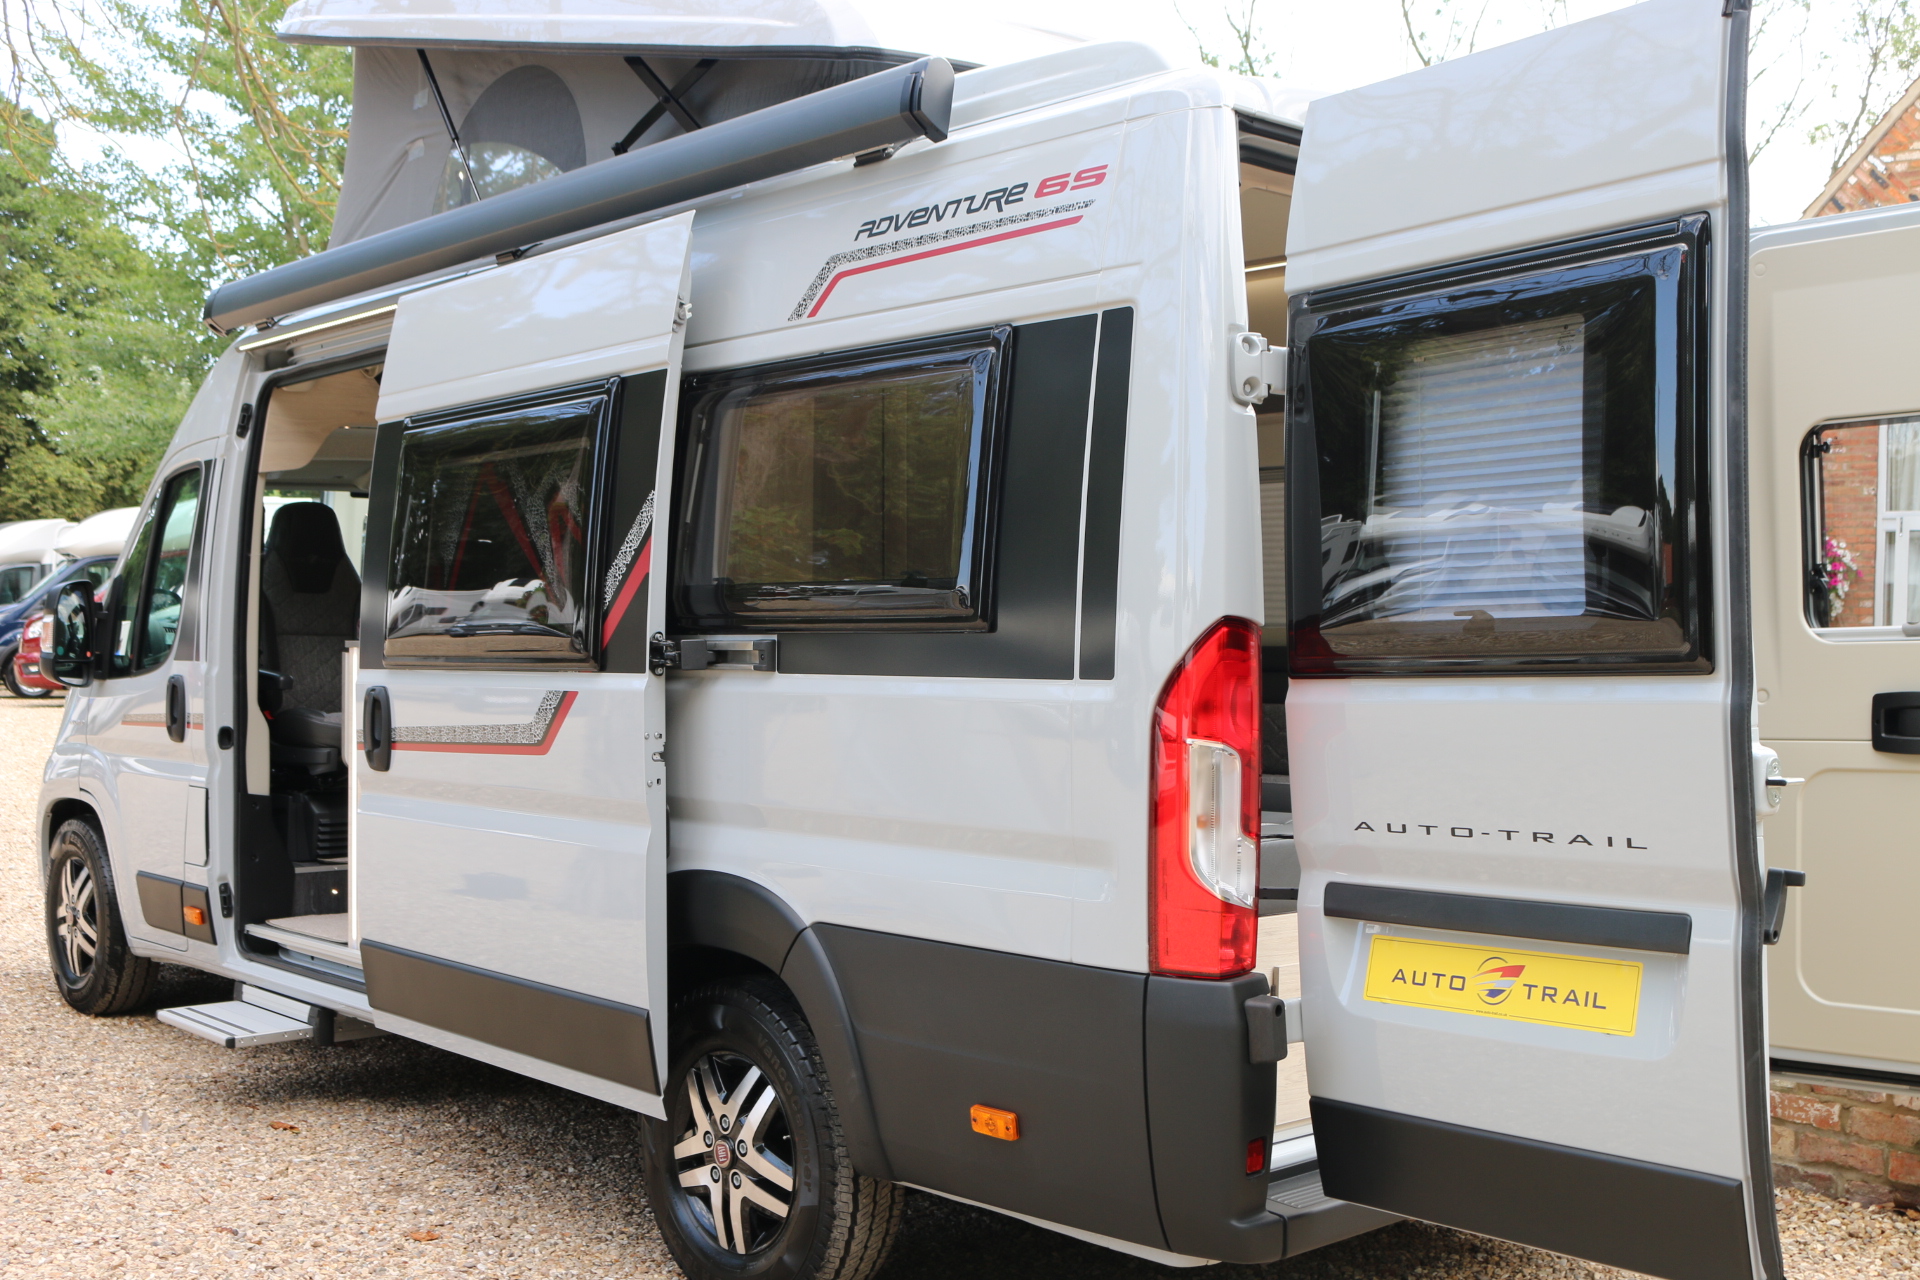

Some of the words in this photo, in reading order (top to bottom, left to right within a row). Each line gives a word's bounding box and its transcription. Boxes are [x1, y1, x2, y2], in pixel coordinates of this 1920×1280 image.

[1354, 821, 1648, 850] AUTO-TRAIL
[1391, 968, 1467, 992] AUTO
[1522, 983, 1607, 1010] TRAIL
[717, 1145, 729, 1162] FIAT
